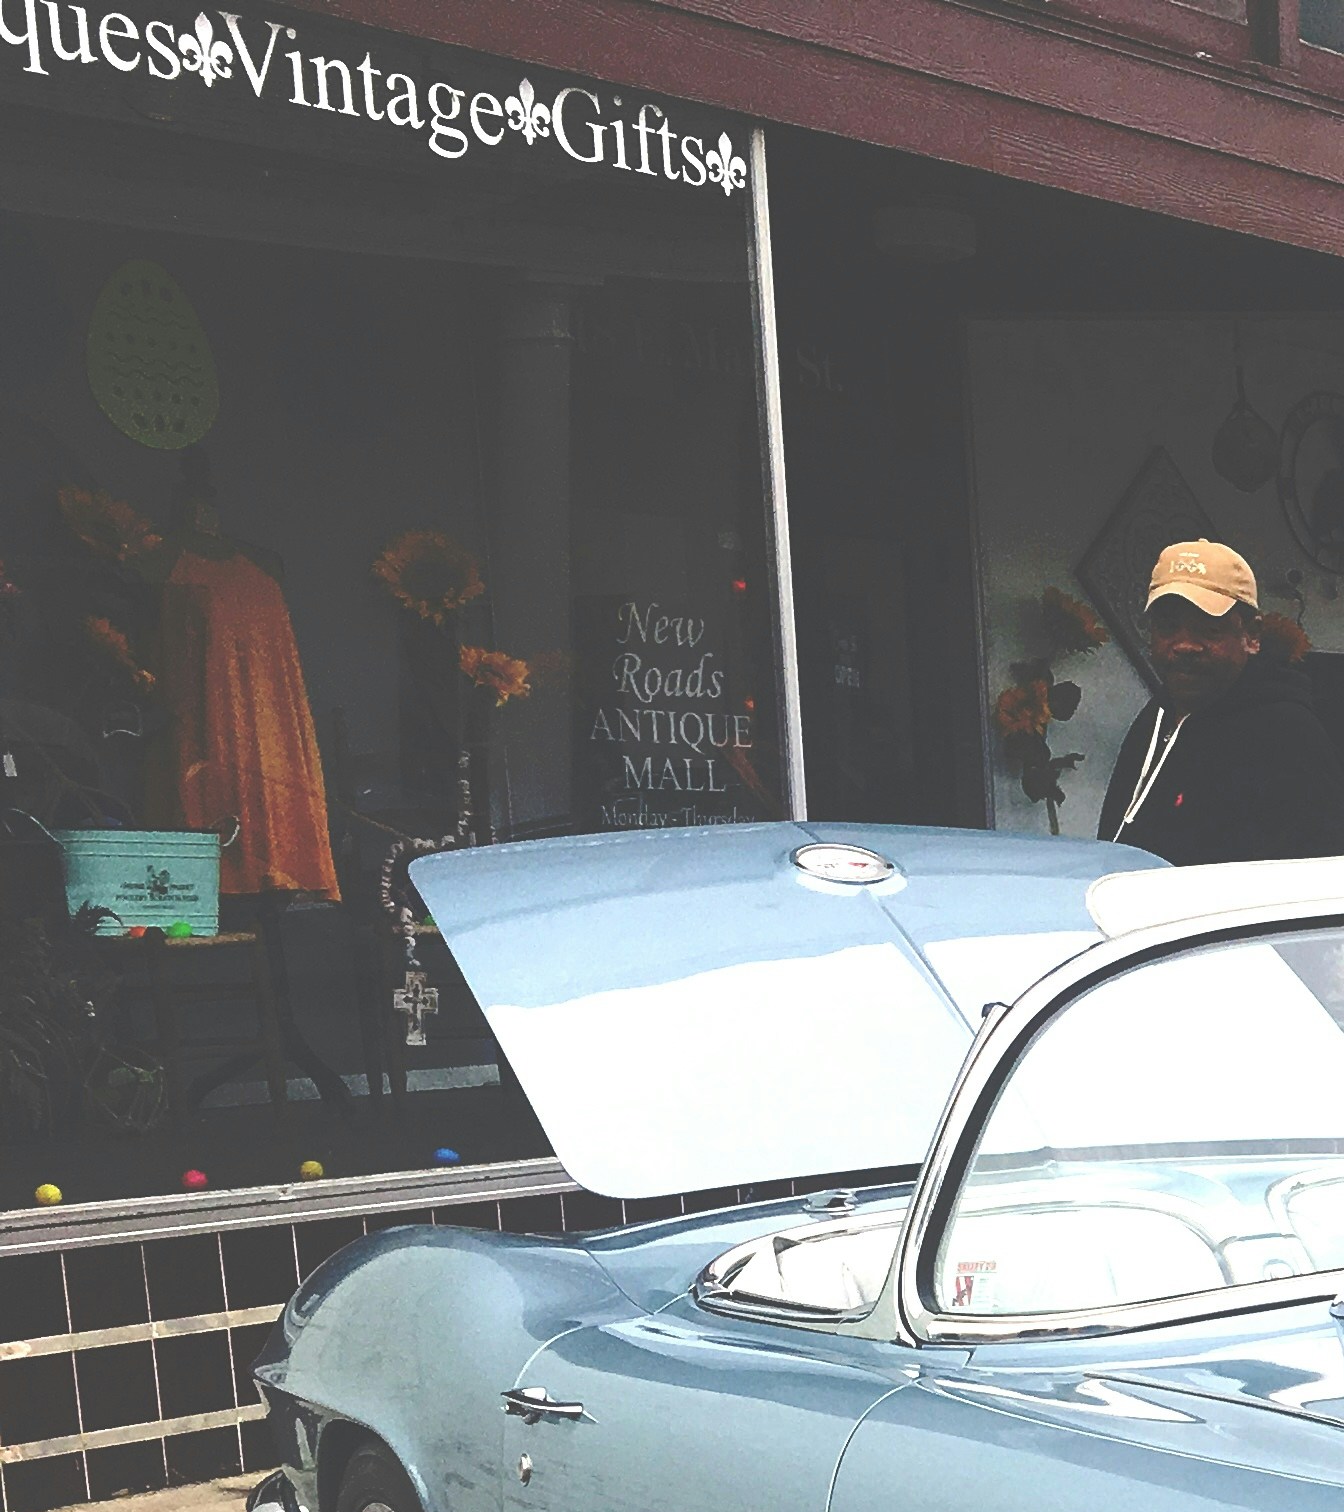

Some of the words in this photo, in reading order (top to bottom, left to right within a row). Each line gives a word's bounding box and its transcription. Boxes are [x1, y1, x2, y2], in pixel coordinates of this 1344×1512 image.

[218, 12, 504, 159] Vintage
[551, 87, 706, 187] Gifts
[616, 601, 705, 648] New
[613, 652, 724, 703] Roads
[590, 708, 753, 754] ANTIQUE
[623, 755, 726, 792] MALL
